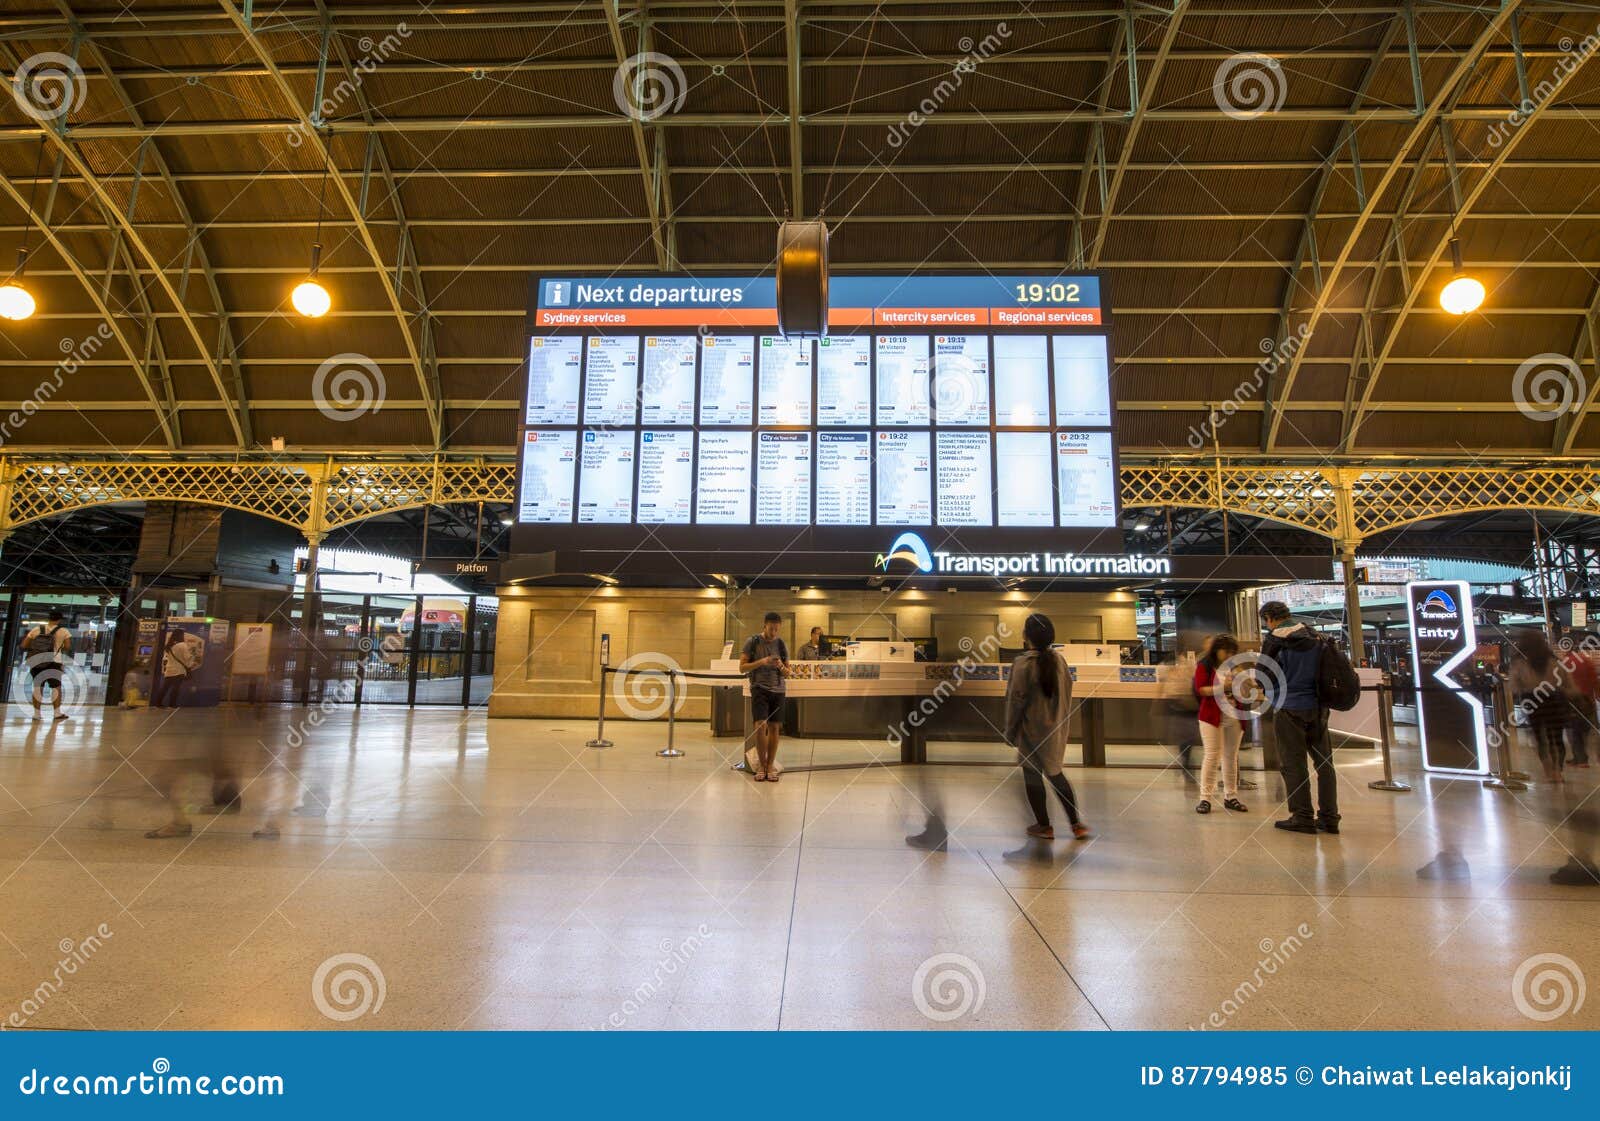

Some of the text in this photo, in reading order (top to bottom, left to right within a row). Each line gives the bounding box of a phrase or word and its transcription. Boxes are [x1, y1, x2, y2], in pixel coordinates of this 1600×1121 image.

[577, 284, 743, 307] Next departures
[1016, 284, 1080, 302] 19:02
[543, 313, 626, 324] Sydney services
[882, 311, 976, 323] Intercity services
[998, 311, 1094, 323] Regional services
[644, 433, 653, 442] T4
[933, 552, 1170, 575] Transport Information
[1421, 611, 1457, 619] Transport
[1417, 627, 1459, 640] Entry
